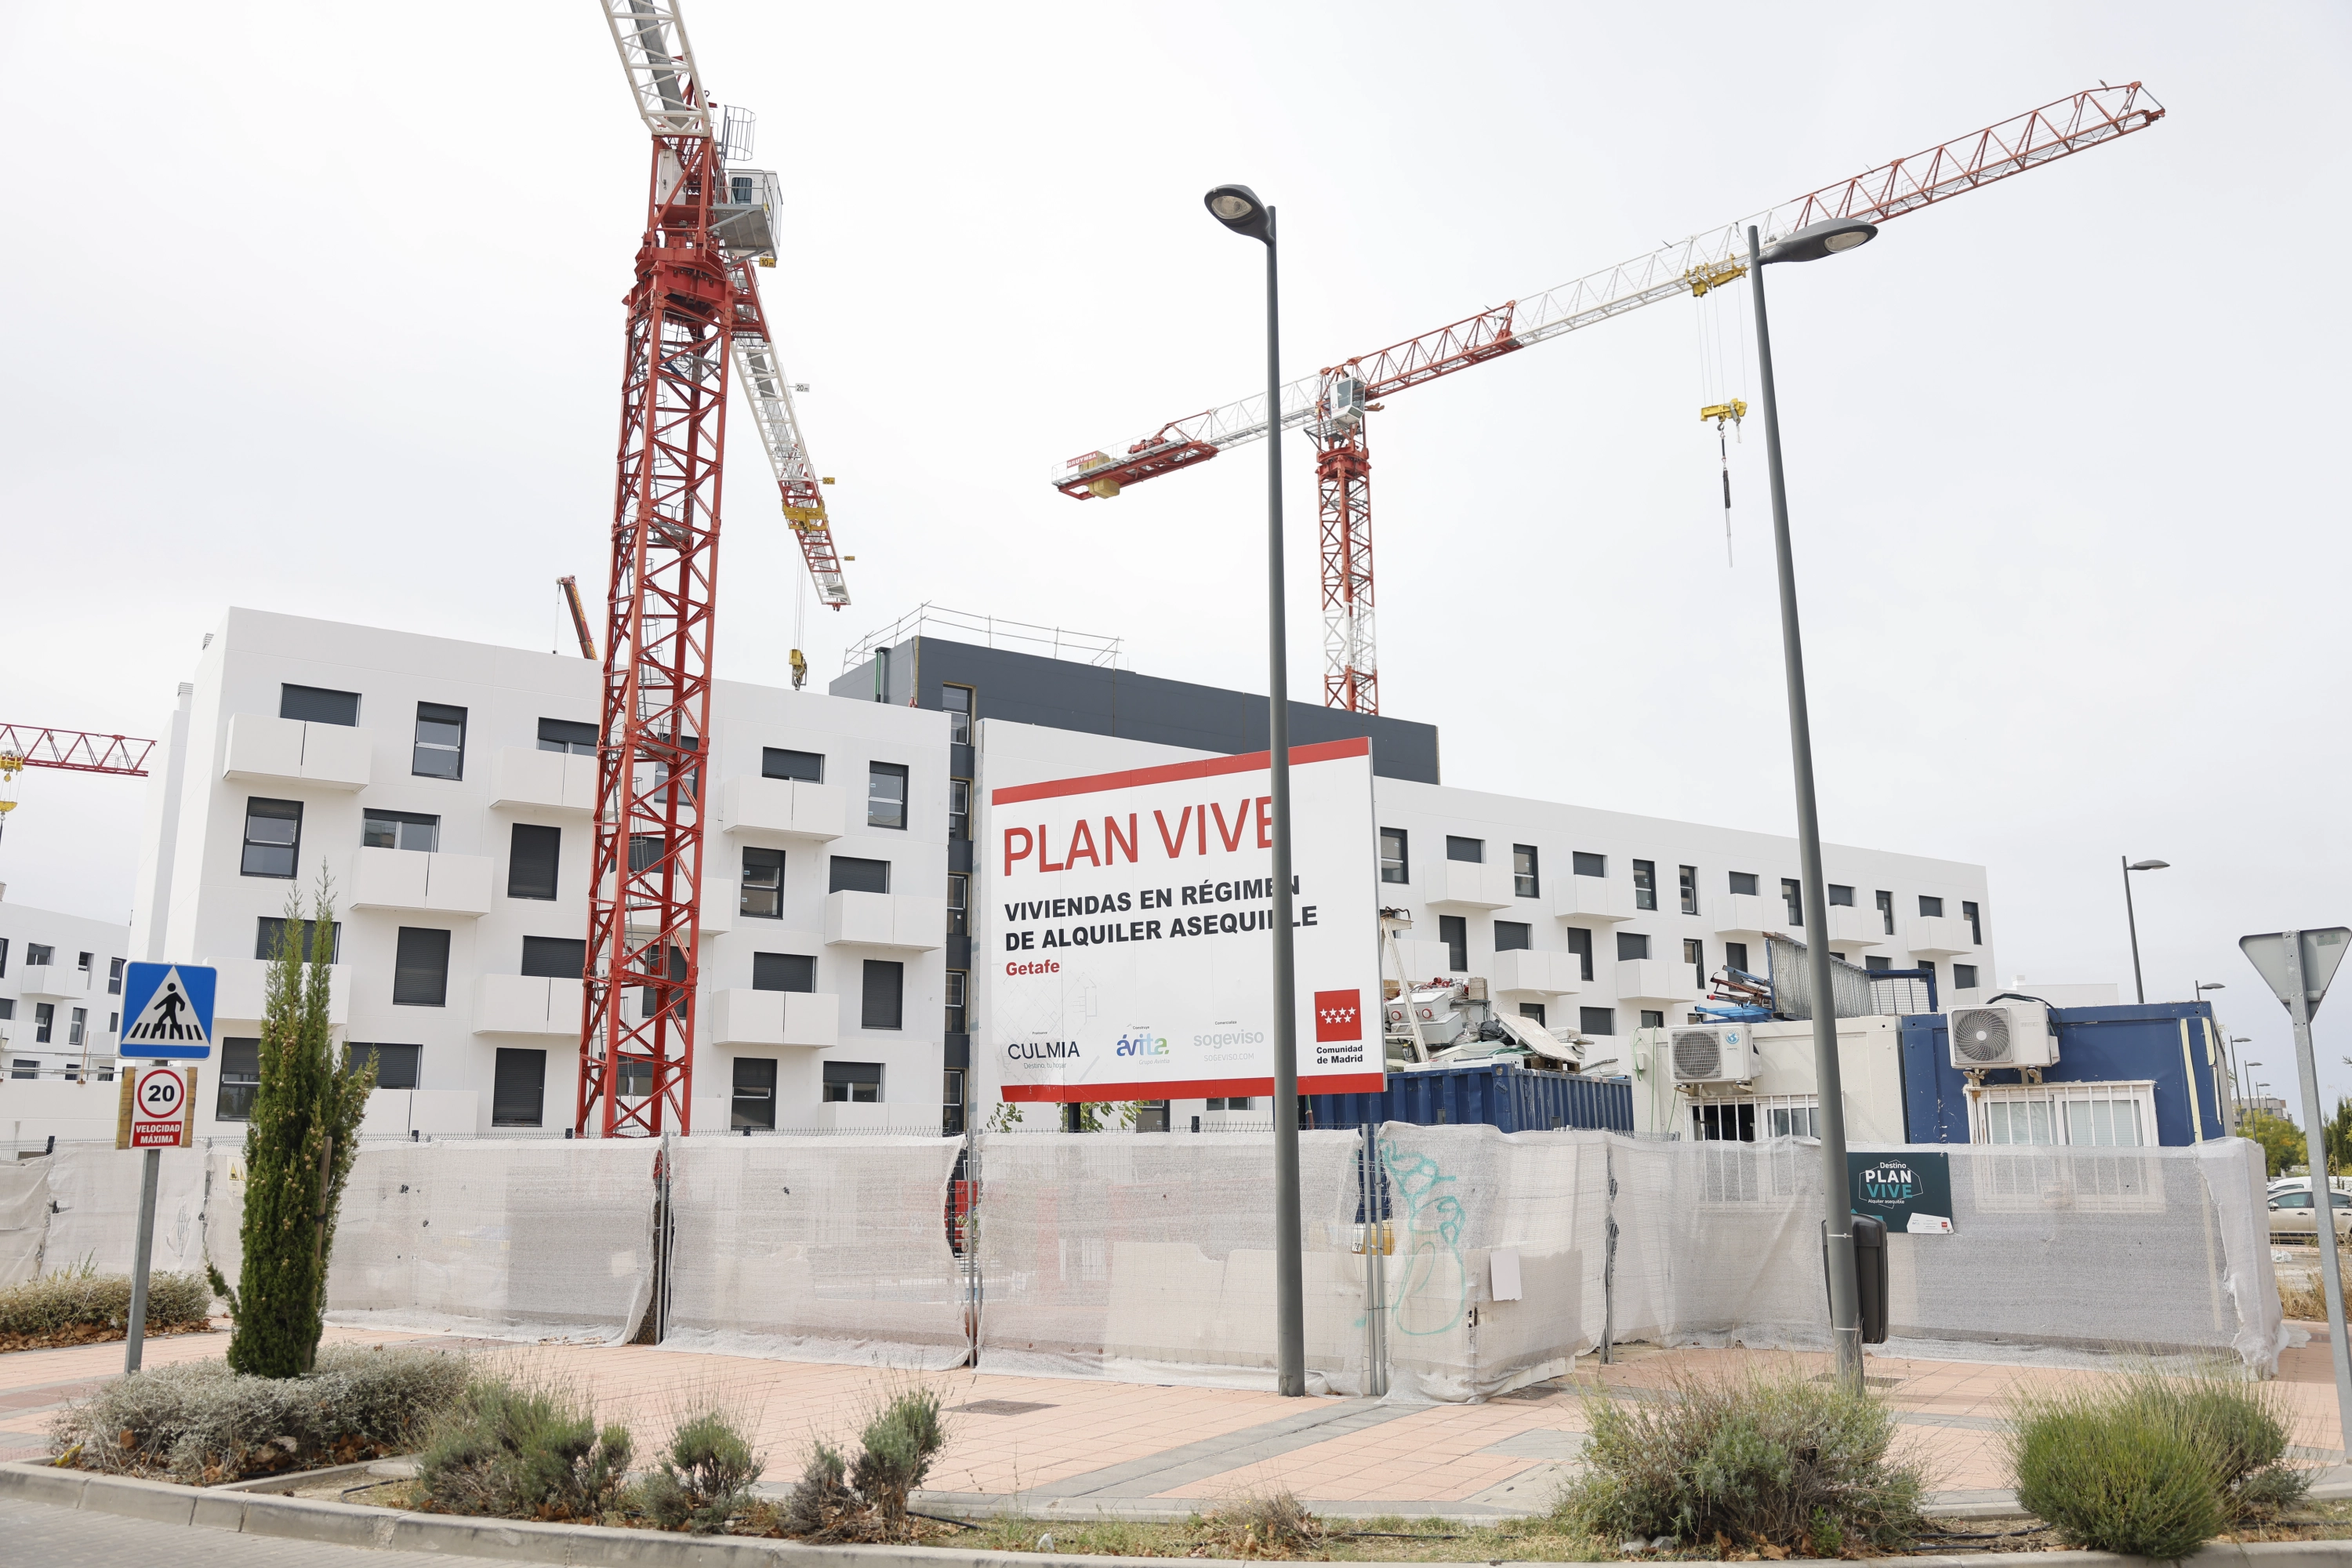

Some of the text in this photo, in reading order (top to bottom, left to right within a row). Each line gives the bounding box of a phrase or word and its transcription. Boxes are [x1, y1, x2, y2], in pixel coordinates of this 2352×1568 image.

[1067, 452, 1097, 466] GRUYMSA
[1004, 796, 1272, 877] PLAN VIVE
[1004, 892, 1131, 921] VIVIENDAS
[1140, 887, 1172, 909] EN
[1006, 906, 1318, 951] DE ALQUILER ASEQUIE
[1006, 959, 1060, 976] Getafe
[1193, 1029, 1264, 1049] sogeviso
[1007, 1041, 1080, 1059] CULMIA
[1316, 1045, 1363, 1054] Comunidad
[1203, 1053, 1254, 1062] SOGEVISO.COM
[1331, 1054, 1363, 1063] Madrid
[147, 1085, 175, 1102] 20
[136, 1124, 180, 1133] VELOCIDAD
[140, 1134, 173, 1144] MÁXIMA
[1865, 1170, 1911, 1183] PLAN
[1866, 1184, 1912, 1198] VIVE
